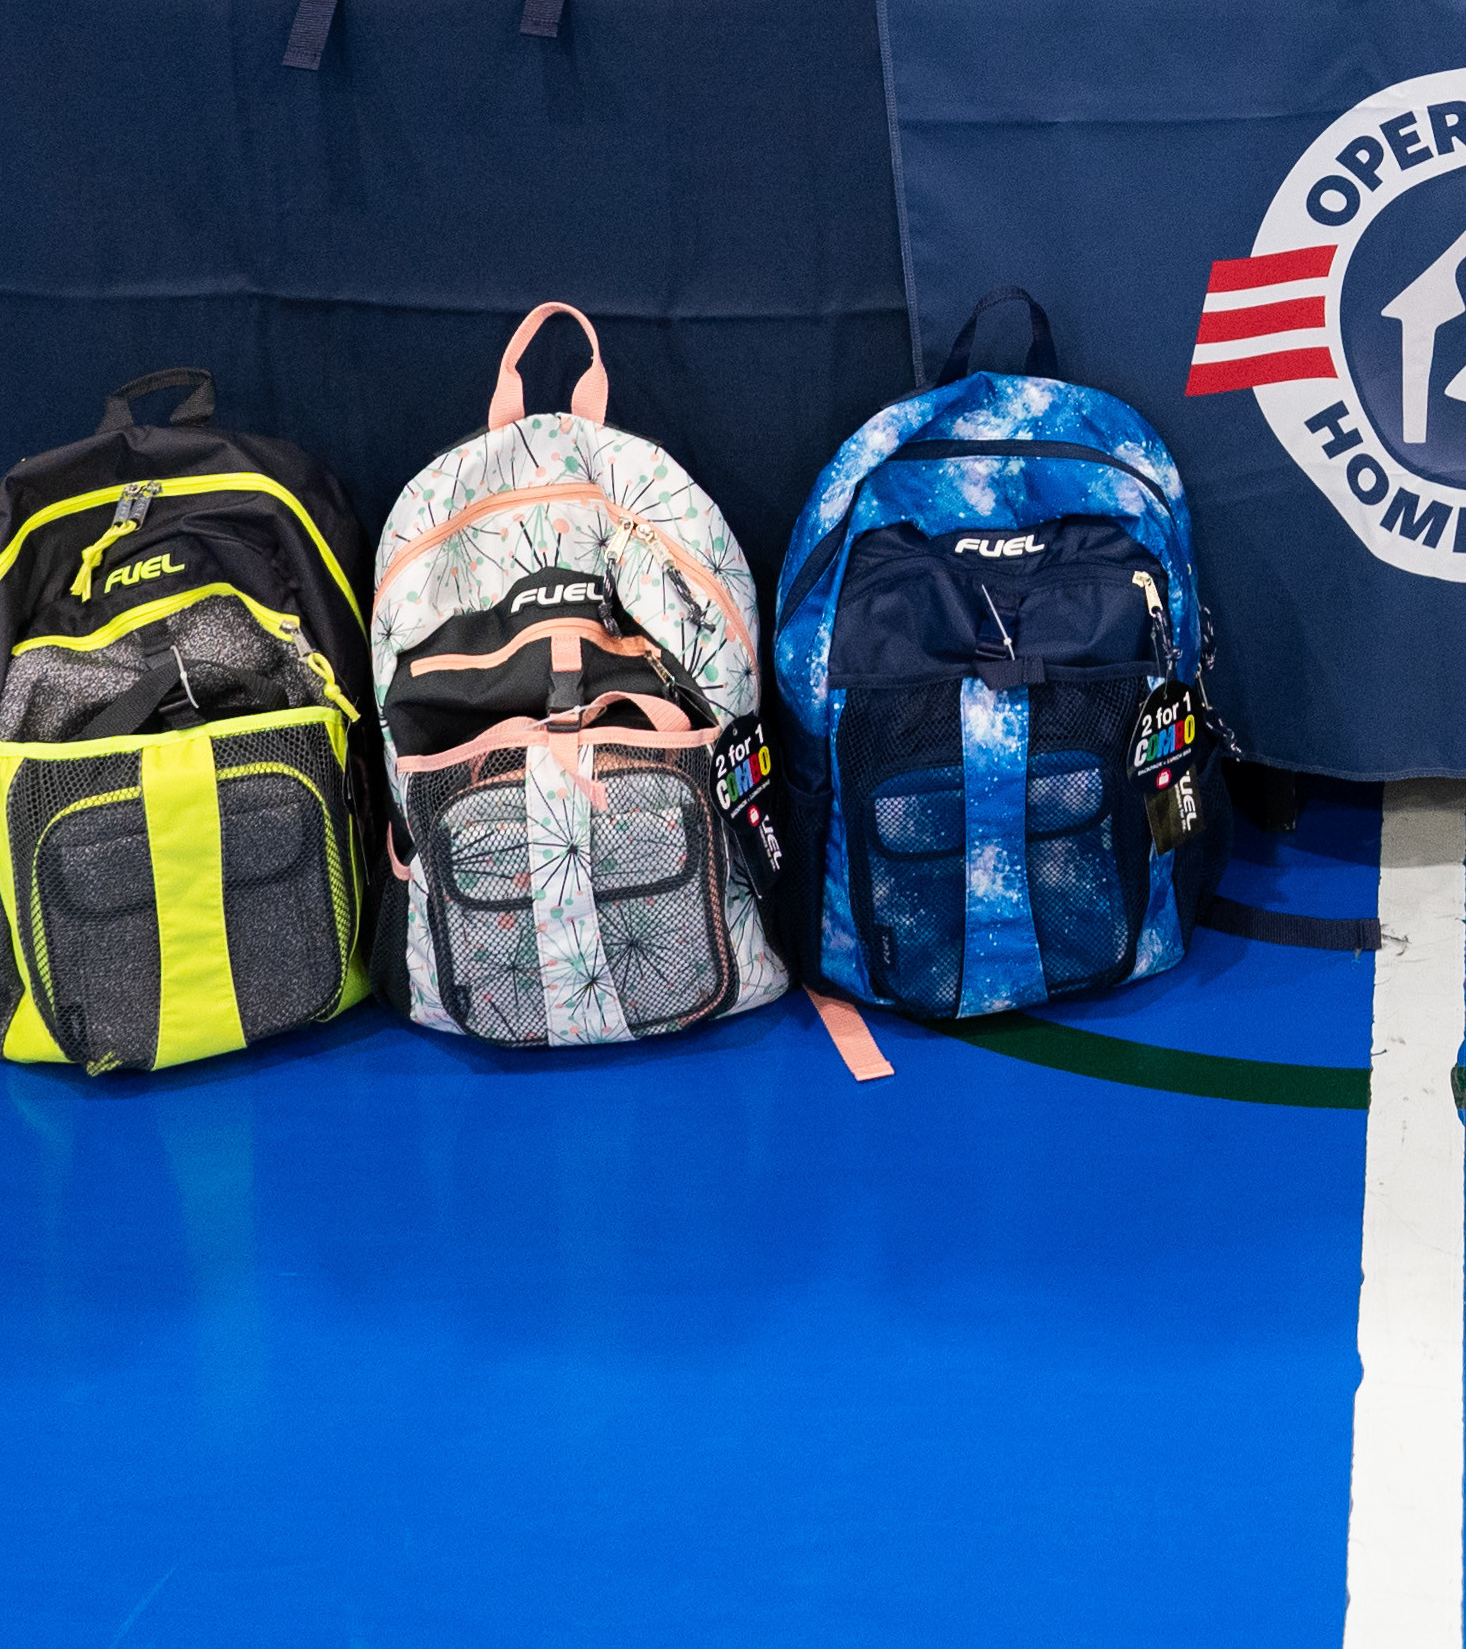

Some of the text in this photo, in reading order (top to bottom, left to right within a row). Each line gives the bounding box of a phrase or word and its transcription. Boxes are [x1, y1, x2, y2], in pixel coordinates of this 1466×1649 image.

[952, 534, 1043, 558] FUEL
[99, 553, 184, 595] FUEL
[508, 582, 604, 613] FUEL
[1141, 691, 1191, 738] 2 for 1
[715, 723, 764, 778] 2 for 1
[1134, 714, 1195, 768] COMBO
[716, 745, 771, 810] COMBO
[1179, 775, 1197, 831] UEL
